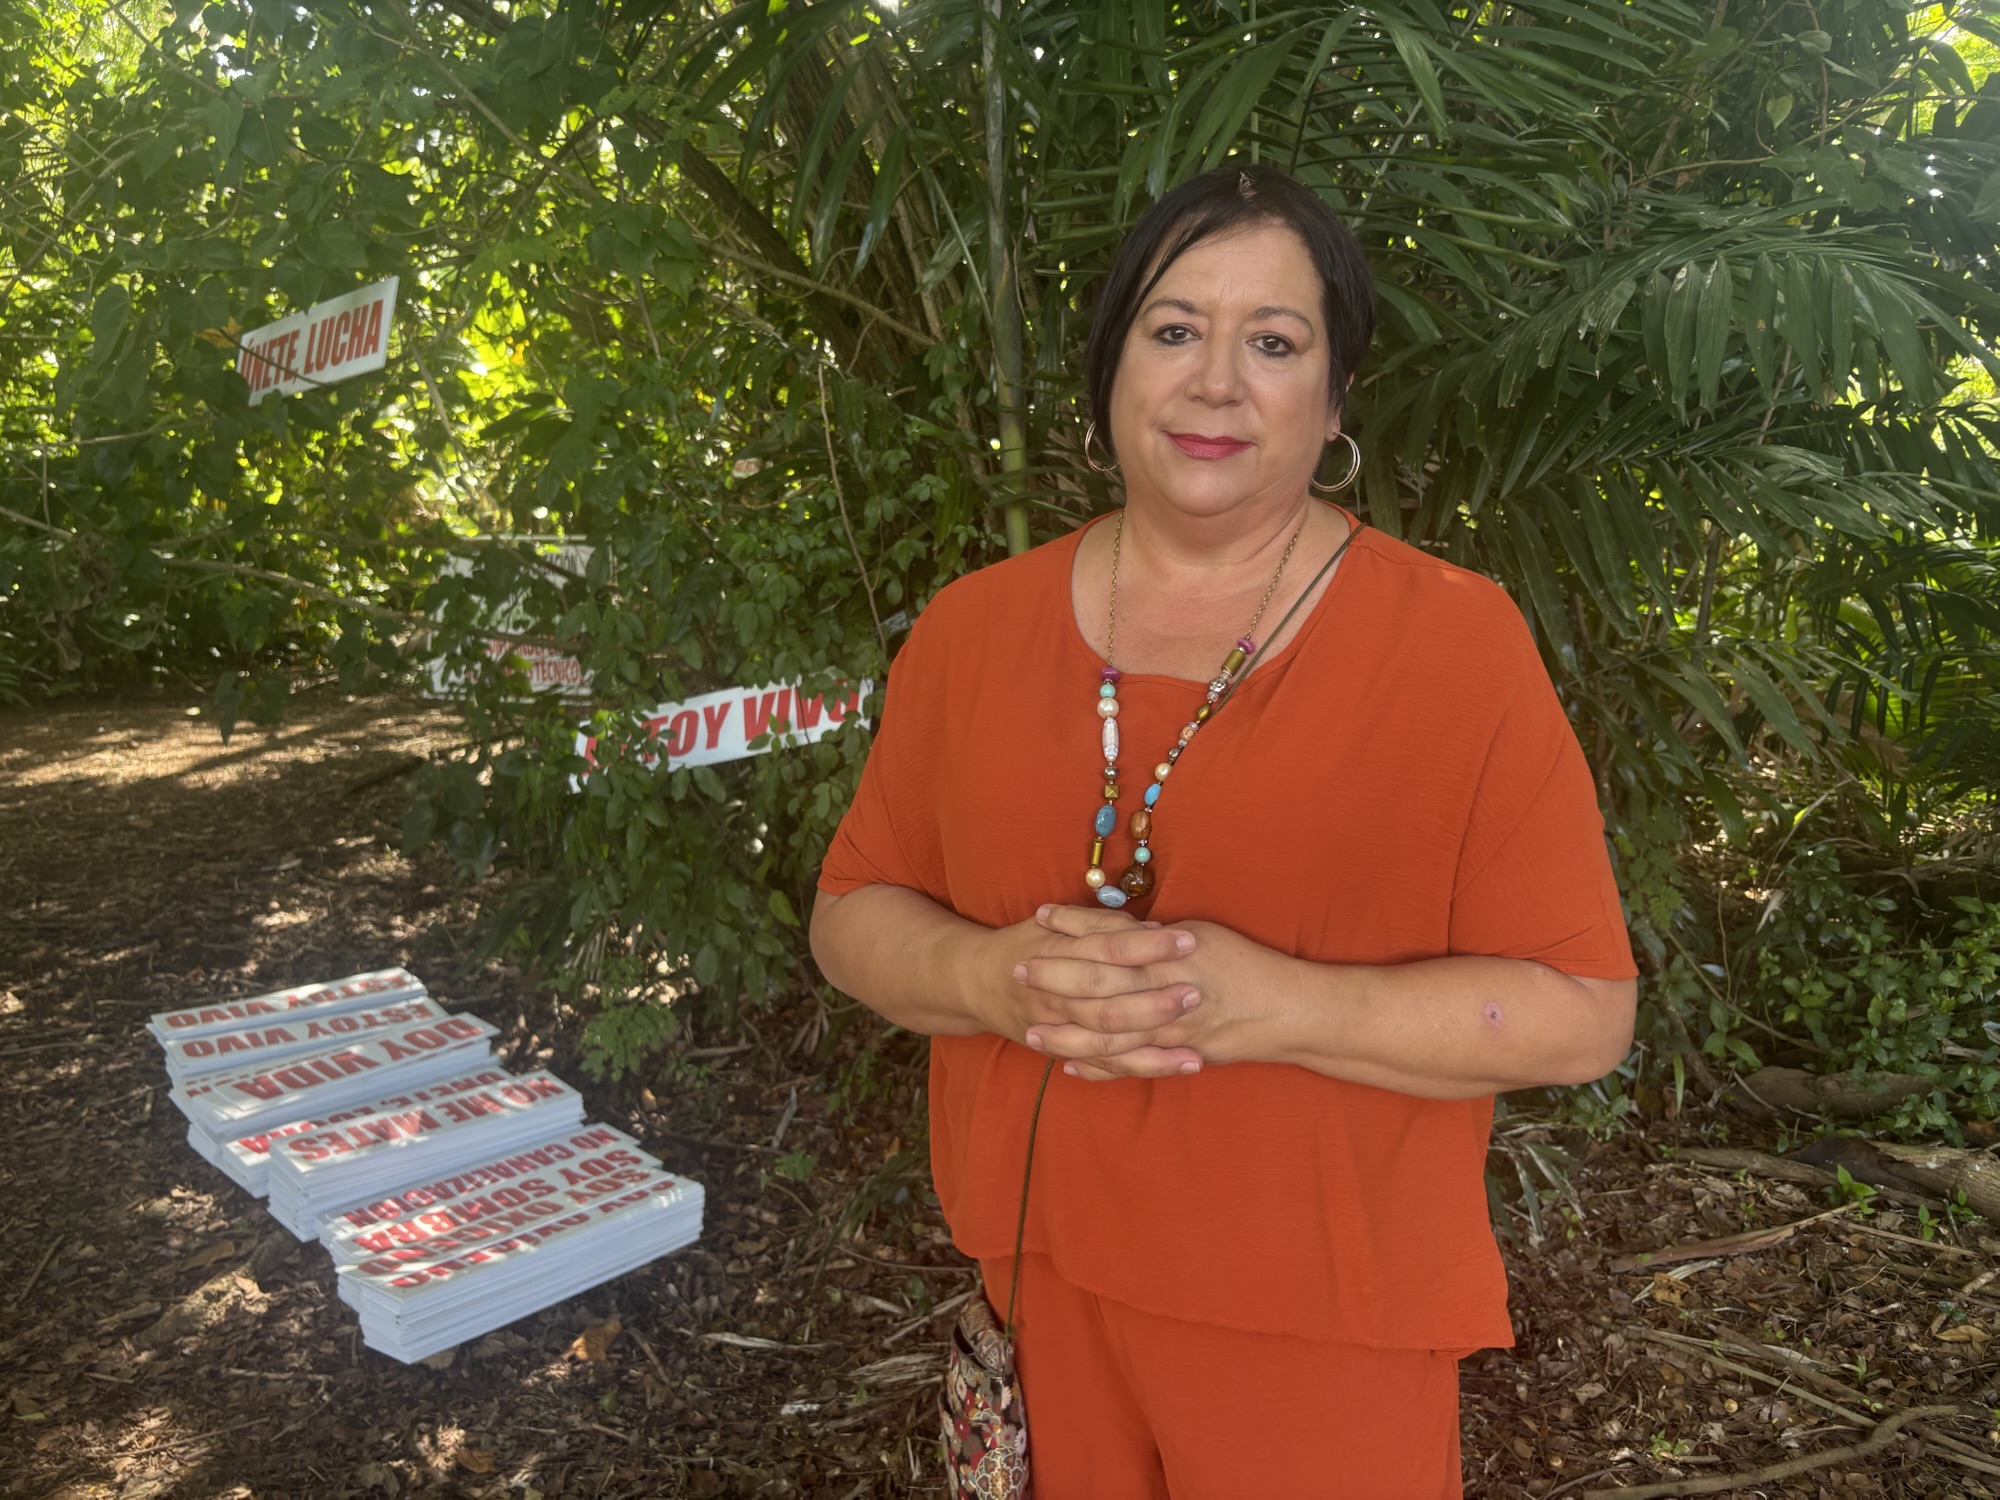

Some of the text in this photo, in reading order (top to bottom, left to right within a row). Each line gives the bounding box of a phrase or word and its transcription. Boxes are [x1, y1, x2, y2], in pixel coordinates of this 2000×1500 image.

[303, 299, 384, 376] LUCHA
[166, 975, 409, 1028] ESTOY VIVO
[182, 1003, 434, 1057] ESTOY VIVO
[378, 1017, 485, 1061] DOY
[233, 1050, 382, 1101] VIDA
[288, 1075, 565, 1161] NO ME MATES
[570, 1128, 620, 1152] NO
[352, 1149, 643, 1255] SOY SOMBRA
[563, 1168, 651, 1205] SOY
